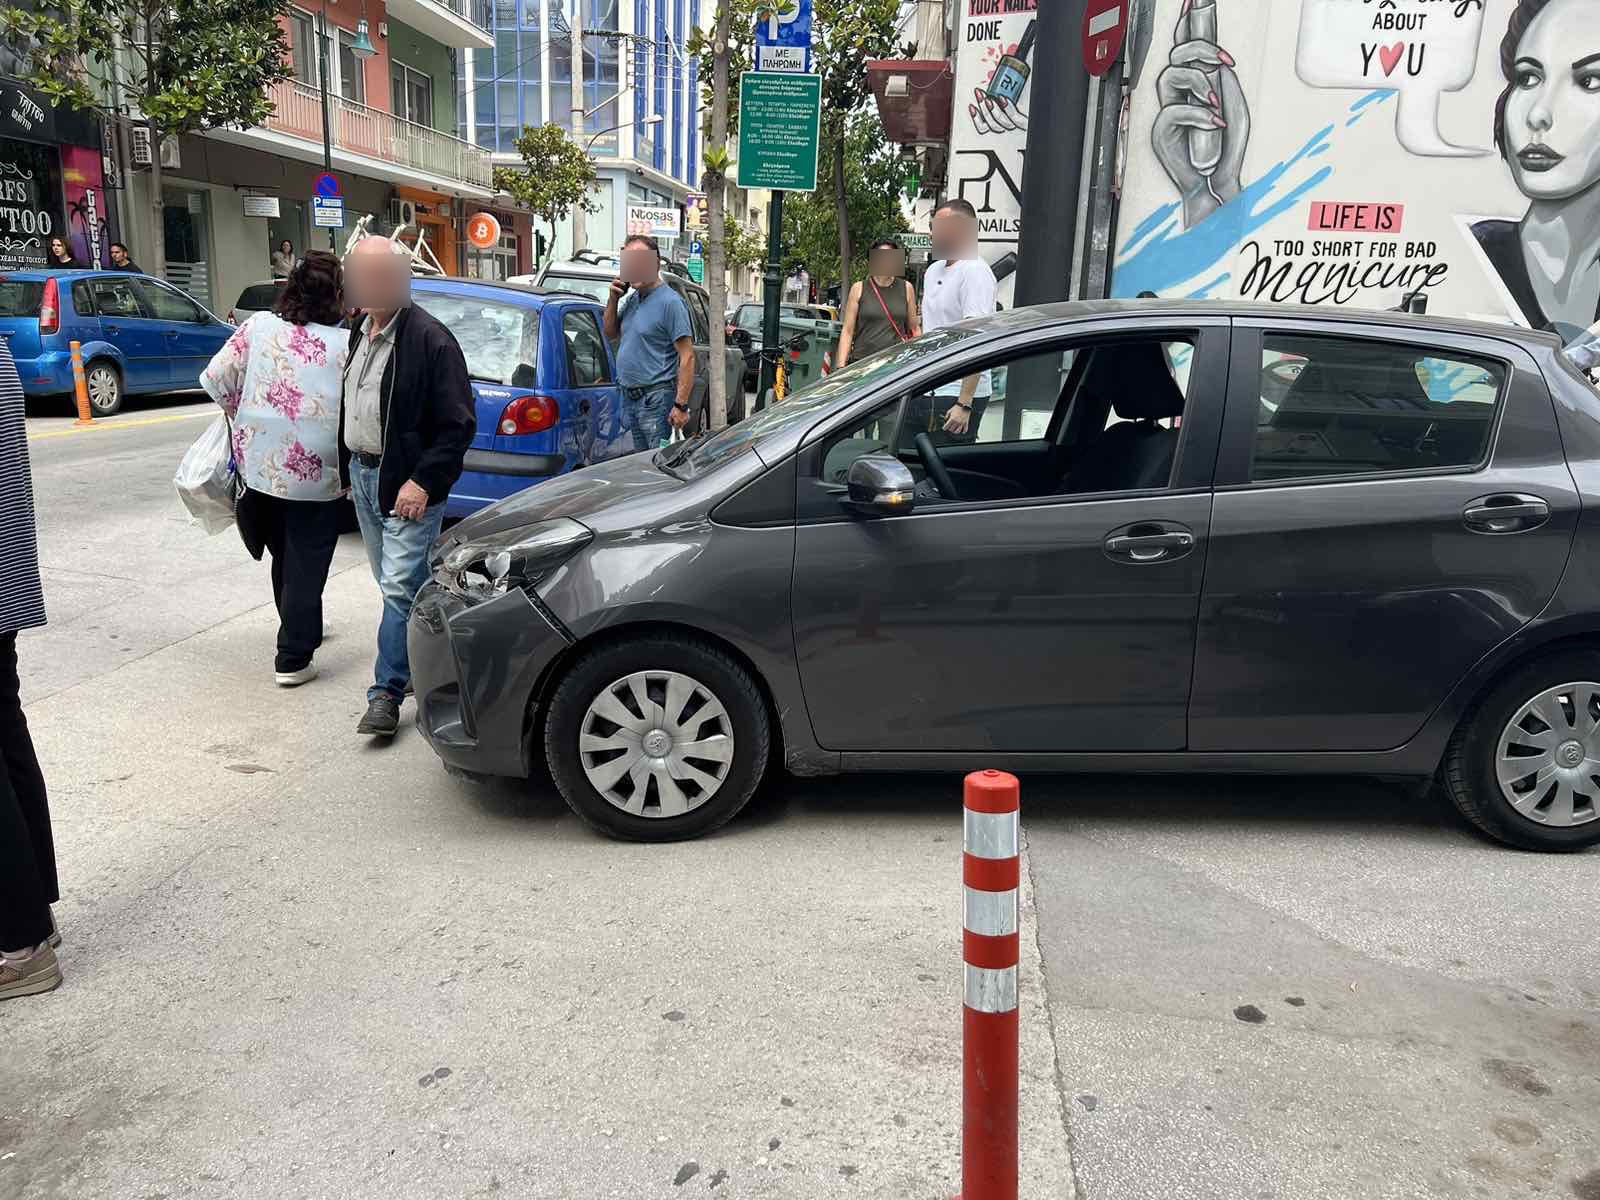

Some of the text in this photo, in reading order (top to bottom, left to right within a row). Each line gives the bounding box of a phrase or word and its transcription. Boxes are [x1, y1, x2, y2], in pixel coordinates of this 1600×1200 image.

[1372, 13, 1427, 30] ABOUT
[967, 20, 1002, 42] DONE
[775, 49, 789, 58] ΜΕ
[763, 59, 801, 69] ΠΛΗΡΩΜΗ
[631, 208, 673, 221] Ntosas
[1319, 204, 1396, 230] LIFE IS
[978, 219, 1023, 232] NAILS
[1273, 240, 1437, 258] TOO SHORT FOR BAD
